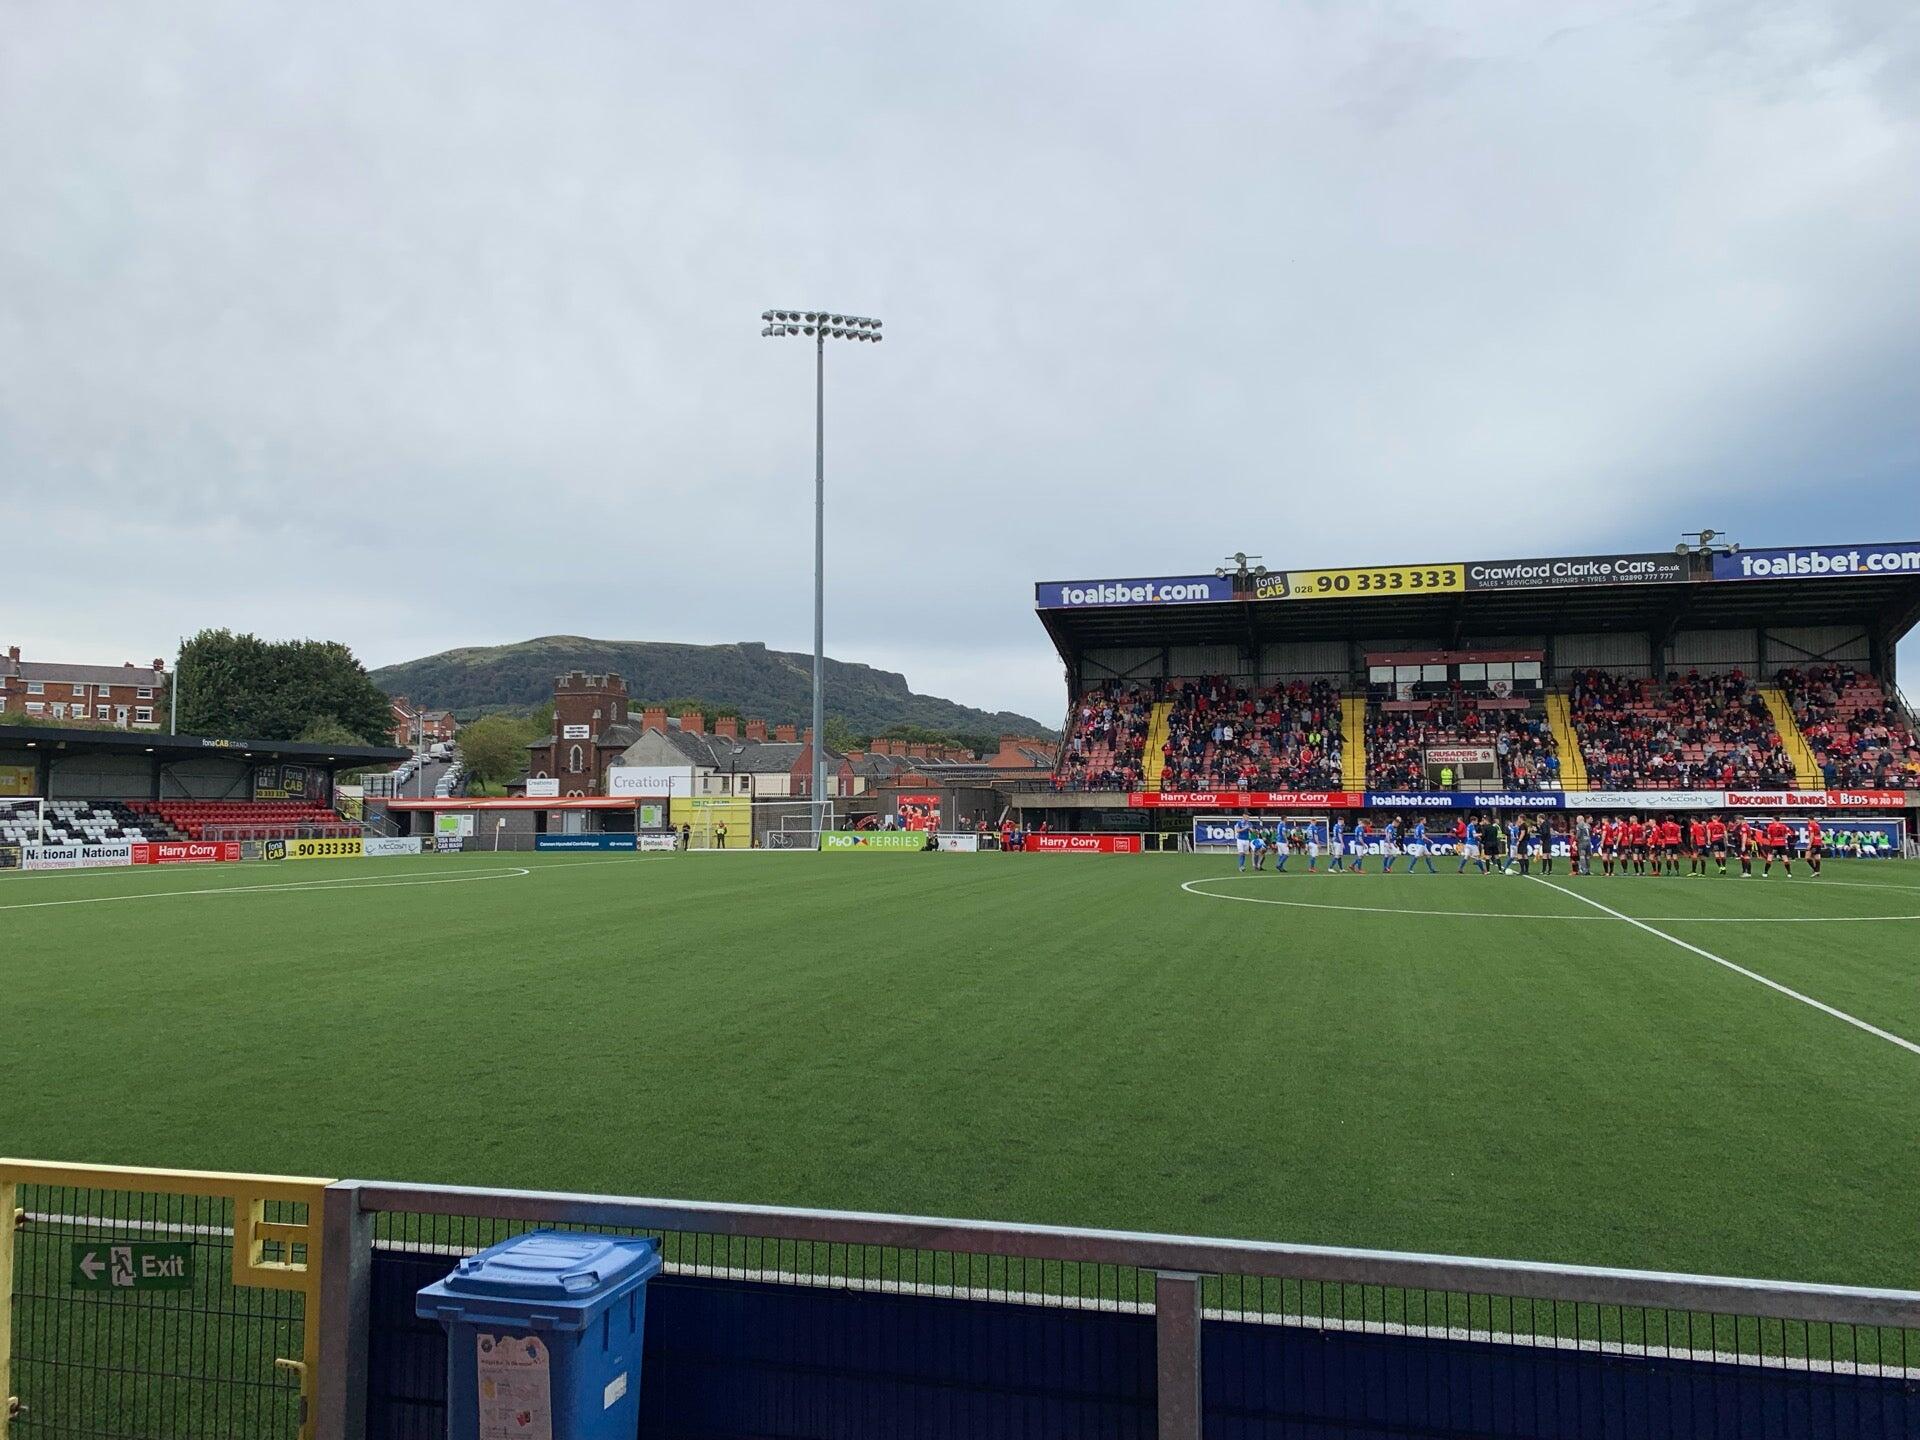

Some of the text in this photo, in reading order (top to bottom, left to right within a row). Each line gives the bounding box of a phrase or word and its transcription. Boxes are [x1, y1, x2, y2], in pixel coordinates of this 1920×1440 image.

[1741, 551, 1920, 576] toalsbet.com
[1471, 562, 1550, 580] Crawford
[1553, 560, 1611, 576] Clarke
[1615, 559, 1655, 574] Cars
[1256, 575, 1281, 588] fona
[1317, 570, 1457, 592] 90 333 333
[1507, 578, 1543, 587] SERVICING
[1552, 576, 1579, 584] REPAIRS
[1659, 572, 1674, 580] 777
[1061, 583, 1210, 604] toalsbet.com
[1256, 586, 1285, 599] CAB
[1295, 585, 1313, 593] 028
[285, 769, 303, 779] fona
[283, 780, 303, 791] CAB
[614, 776, 675, 789] Creations
[1160, 794, 1217, 802] Harry Corry
[1269, 793, 1328, 803] Harry Corry
[1371, 795, 1451, 806] toalsbet.com
[1474, 795, 1557, 806] toalsbet.com
[1828, 795, 1836, 804] &
[269, 842, 283, 850] fona
[829, 836, 919, 847] P&O FERRIES
[1040, 837, 1100, 848] Harry Corry
[82, 847, 129, 858] National
[159, 845, 216, 857] Harry Corry
[268, 849, 284, 859] CAB
[299, 844, 315, 855] 90
[317, 843, 338, 854] 333
[340, 842, 361, 853] 333
[142, 1254, 184, 1277] Exit
